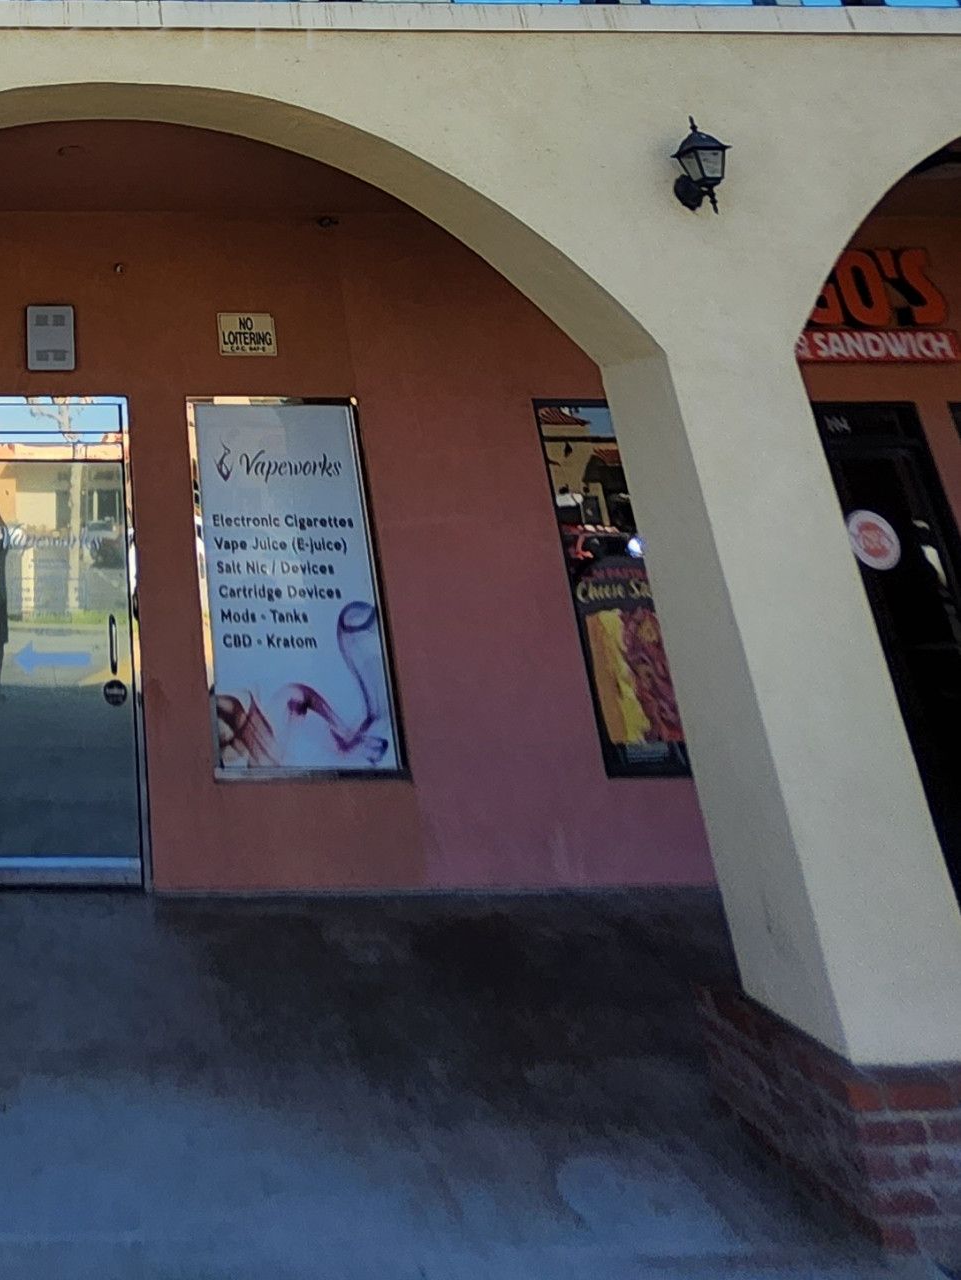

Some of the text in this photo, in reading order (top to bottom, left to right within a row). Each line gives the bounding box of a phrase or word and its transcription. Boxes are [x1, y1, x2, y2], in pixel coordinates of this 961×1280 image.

[238, 316, 254, 331] NO
[222, 330, 273, 346] LOITERING
[813, 331, 956, 360] SANDWICH
[239, 449, 342, 483] Vapeworks
[212, 513, 354, 530] Electronic Cigarettes
[214, 536, 348, 556] Vape Juice (E-juice)
[216, 561, 241, 575] Salt
[246, 561, 268, 575] Nic
[280, 561, 335, 575] Devices
[219, 585, 342, 602] Cartridge Devices
[220, 609, 309, 624] Mods Tanks
[222, 634, 318, 648] CBD Kratom
